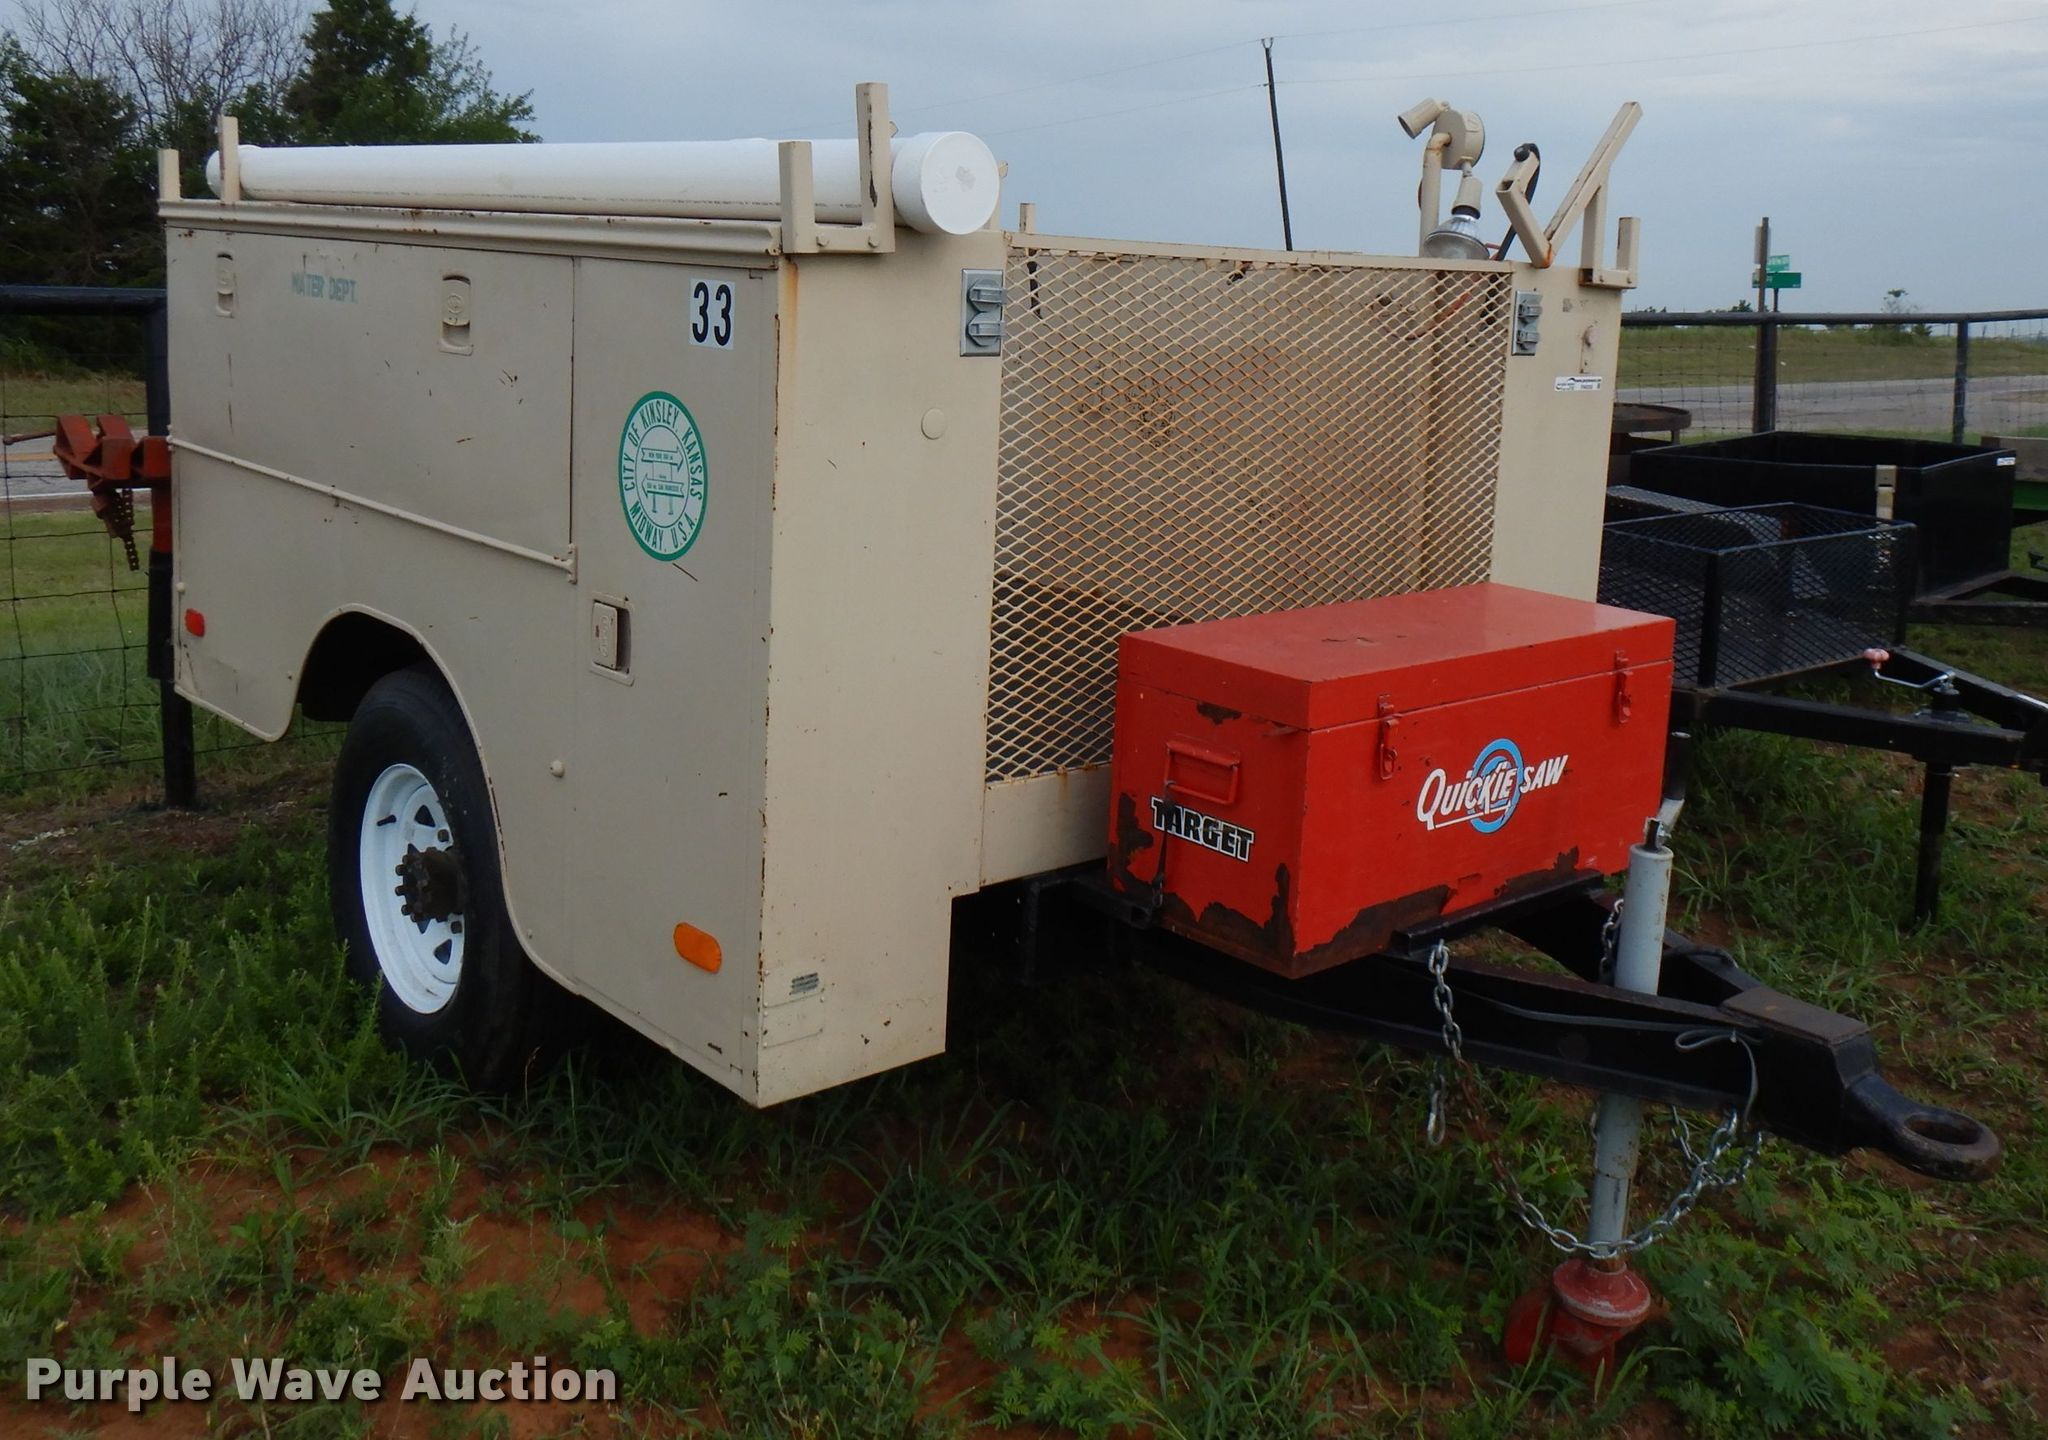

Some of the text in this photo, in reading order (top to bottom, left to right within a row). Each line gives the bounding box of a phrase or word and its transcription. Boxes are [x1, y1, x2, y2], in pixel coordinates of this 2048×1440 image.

[291, 272, 324, 298] WATER
[692, 281, 731, 346] 33
[628, 423, 641, 447] OF
[623, 453, 635, 491] CITY
[681, 427, 703, 500] KANSAS
[671, 512, 698, 548] U.S.A.
[1520, 755, 1568, 793] SAW
[1150, 796, 1255, 862] TARGET
